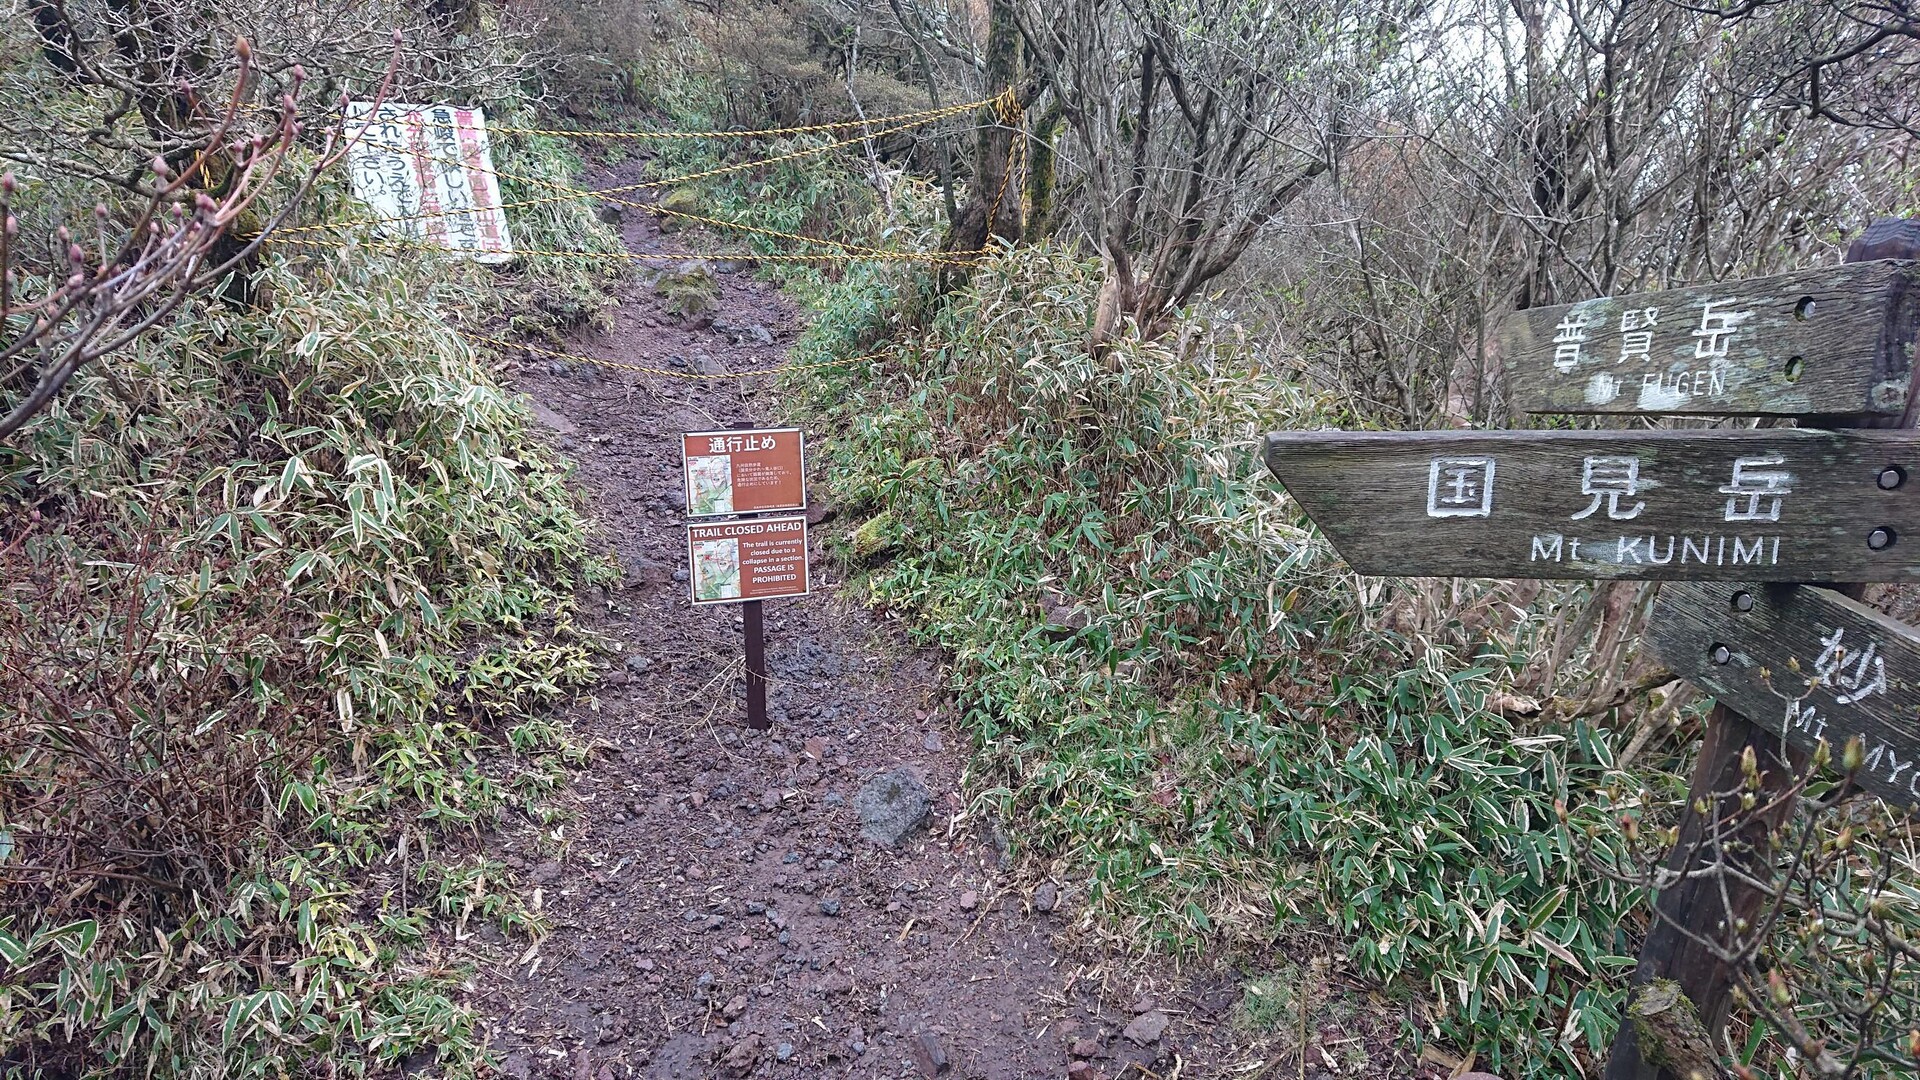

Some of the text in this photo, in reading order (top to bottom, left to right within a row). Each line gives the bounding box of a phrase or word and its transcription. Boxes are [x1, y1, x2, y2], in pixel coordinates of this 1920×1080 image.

[1553, 298, 1751, 369] 普賢岳
[1642, 370, 1726, 397] FUGEN
[708, 435, 776, 453] 通行止め
[1427, 455, 1792, 521] 国見岳
[692, 522, 801, 538] TRAIL CLOSED AHEAD
[775, 538, 803, 546] currently
[1531, 535, 1780, 565] Mt KUNIMI
[753, 565, 786, 573] PASSAGE
[752, 574, 797, 584] PROHIBITED
